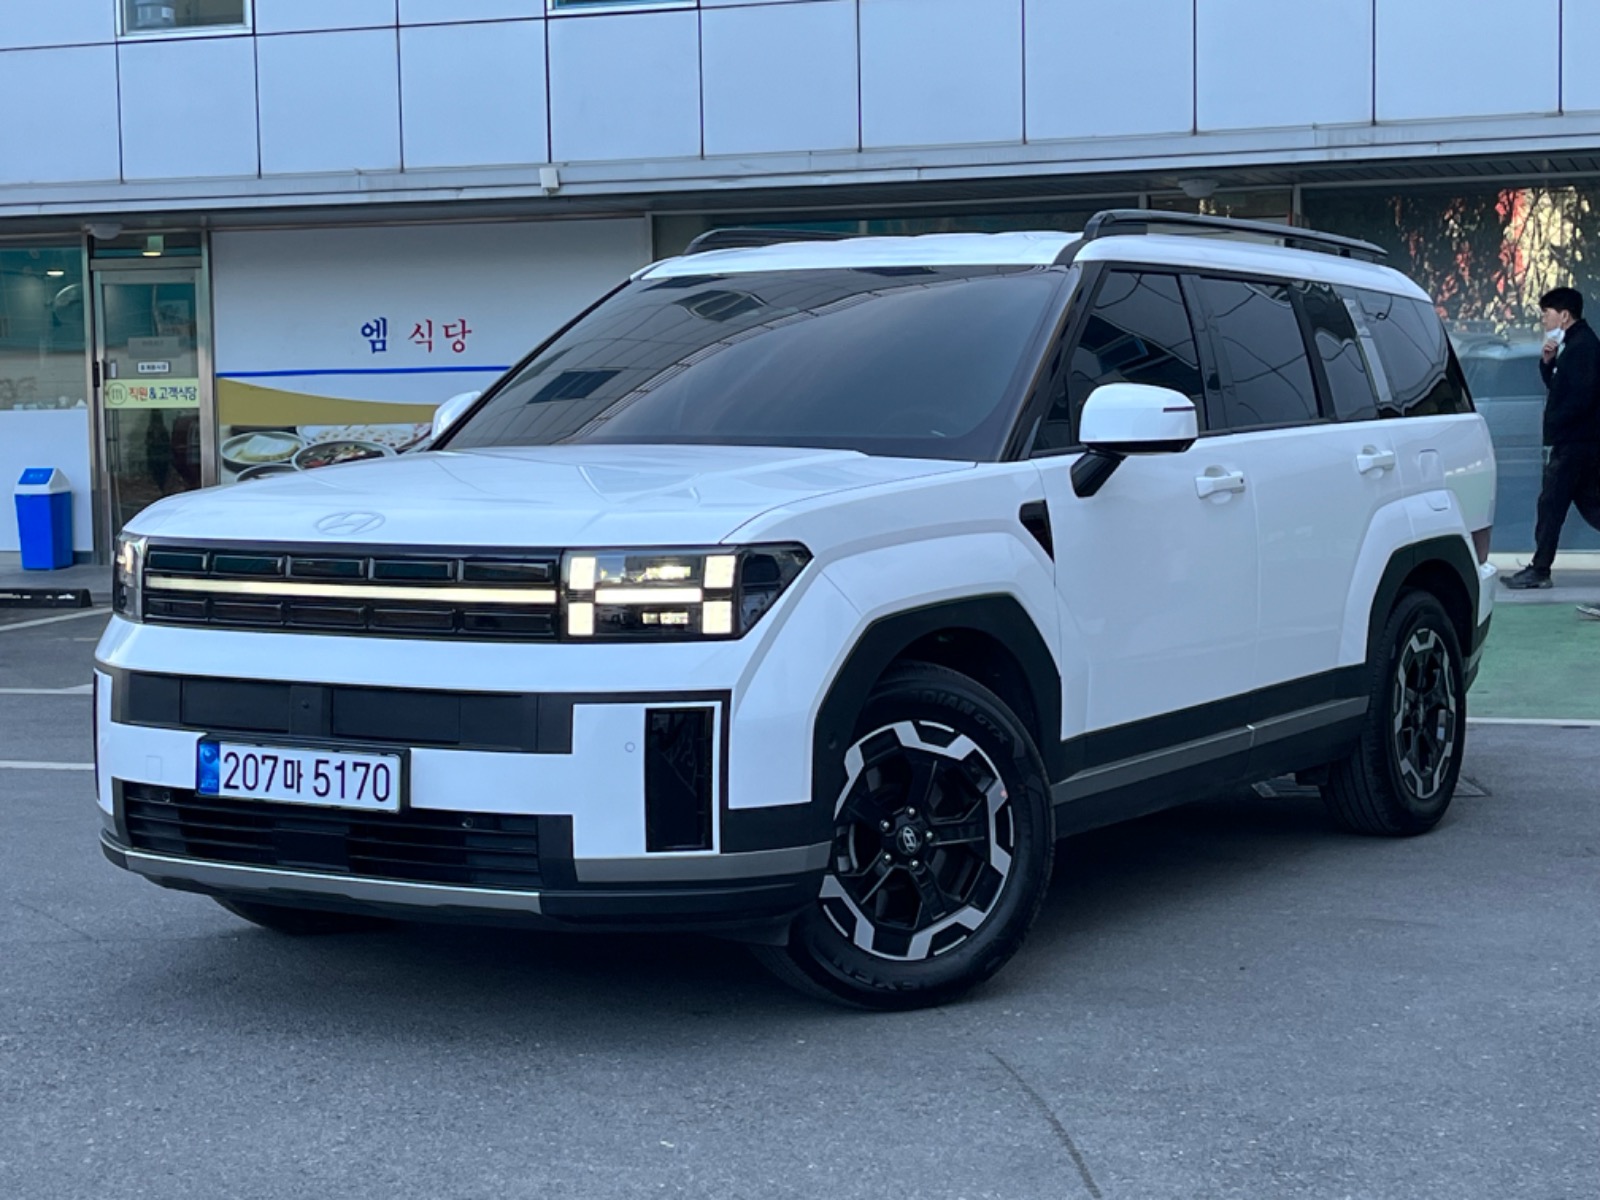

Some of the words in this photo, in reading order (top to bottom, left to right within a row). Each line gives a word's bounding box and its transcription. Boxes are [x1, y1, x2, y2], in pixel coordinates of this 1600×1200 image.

[361, 317, 387, 354] 엠
[408, 318, 473, 354] 식당
[223, 752, 304, 794] 207마
[313, 758, 391, 803] 5170
